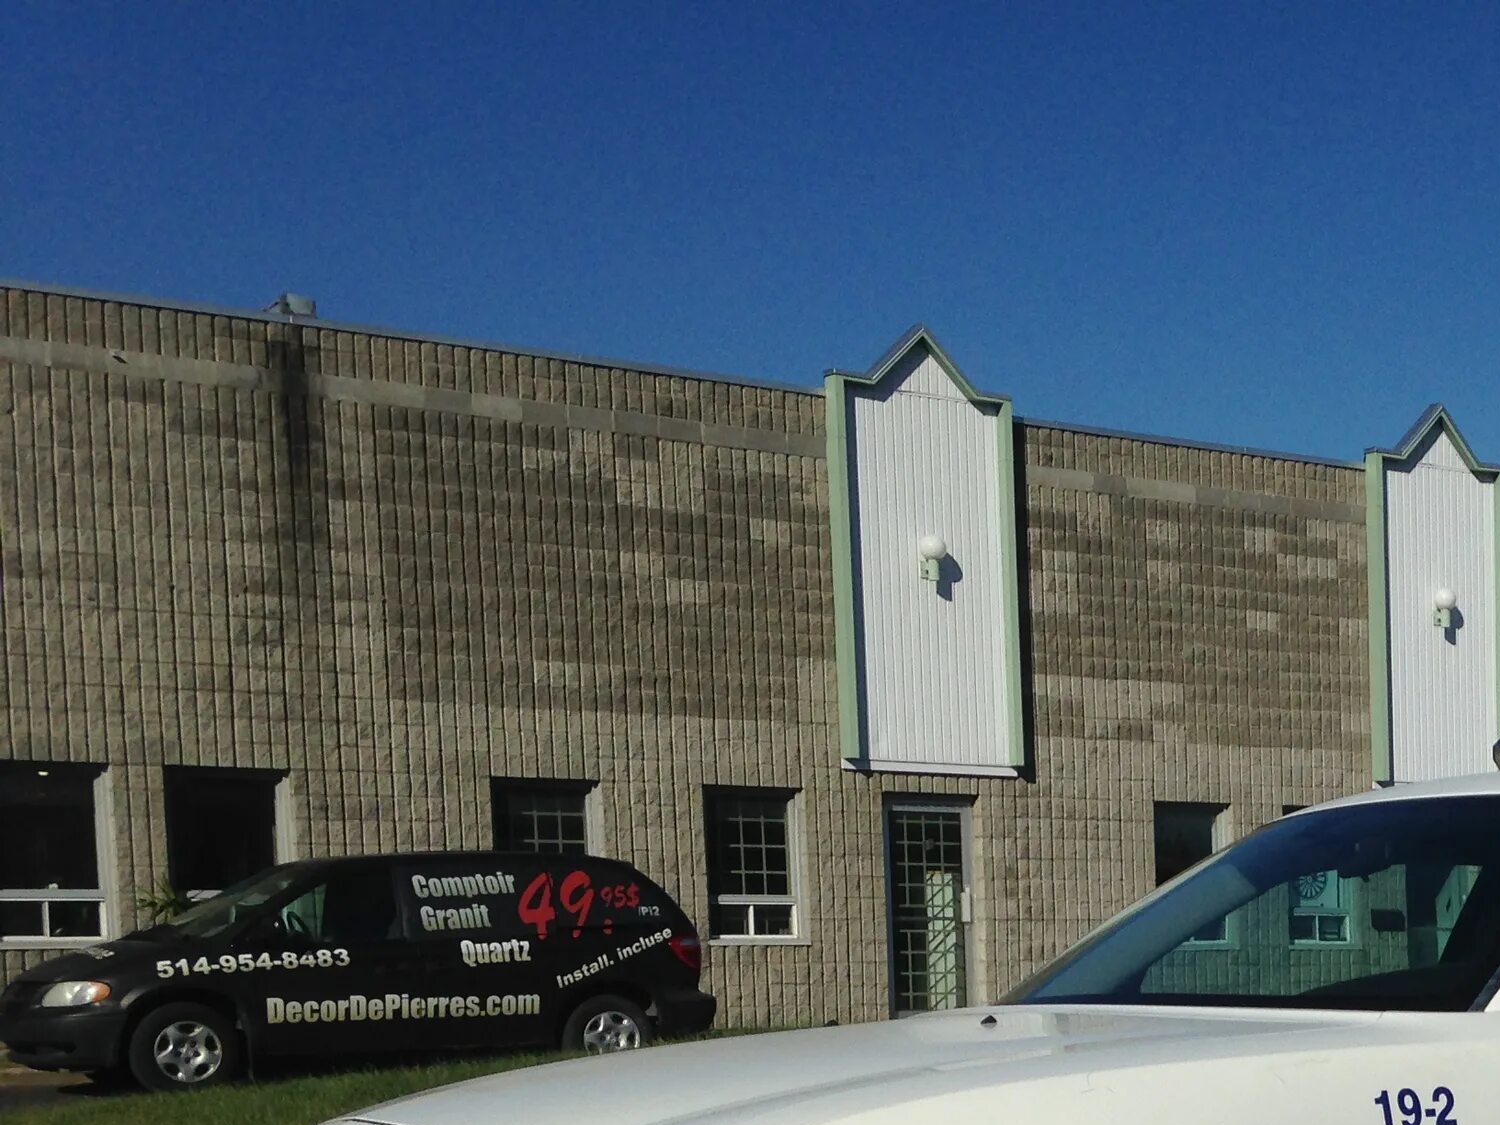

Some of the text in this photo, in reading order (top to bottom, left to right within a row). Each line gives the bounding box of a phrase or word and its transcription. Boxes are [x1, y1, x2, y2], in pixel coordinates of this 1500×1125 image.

[411, 871, 515, 898] Comptoir
[420, 903, 491, 931] Granit
[156, 948, 350, 979] 514-954-8483
[460, 939, 531, 967] Quartz
[556, 927, 673, 988] Install. incluse
[266, 993, 541, 1024] DecorDePierres.com
